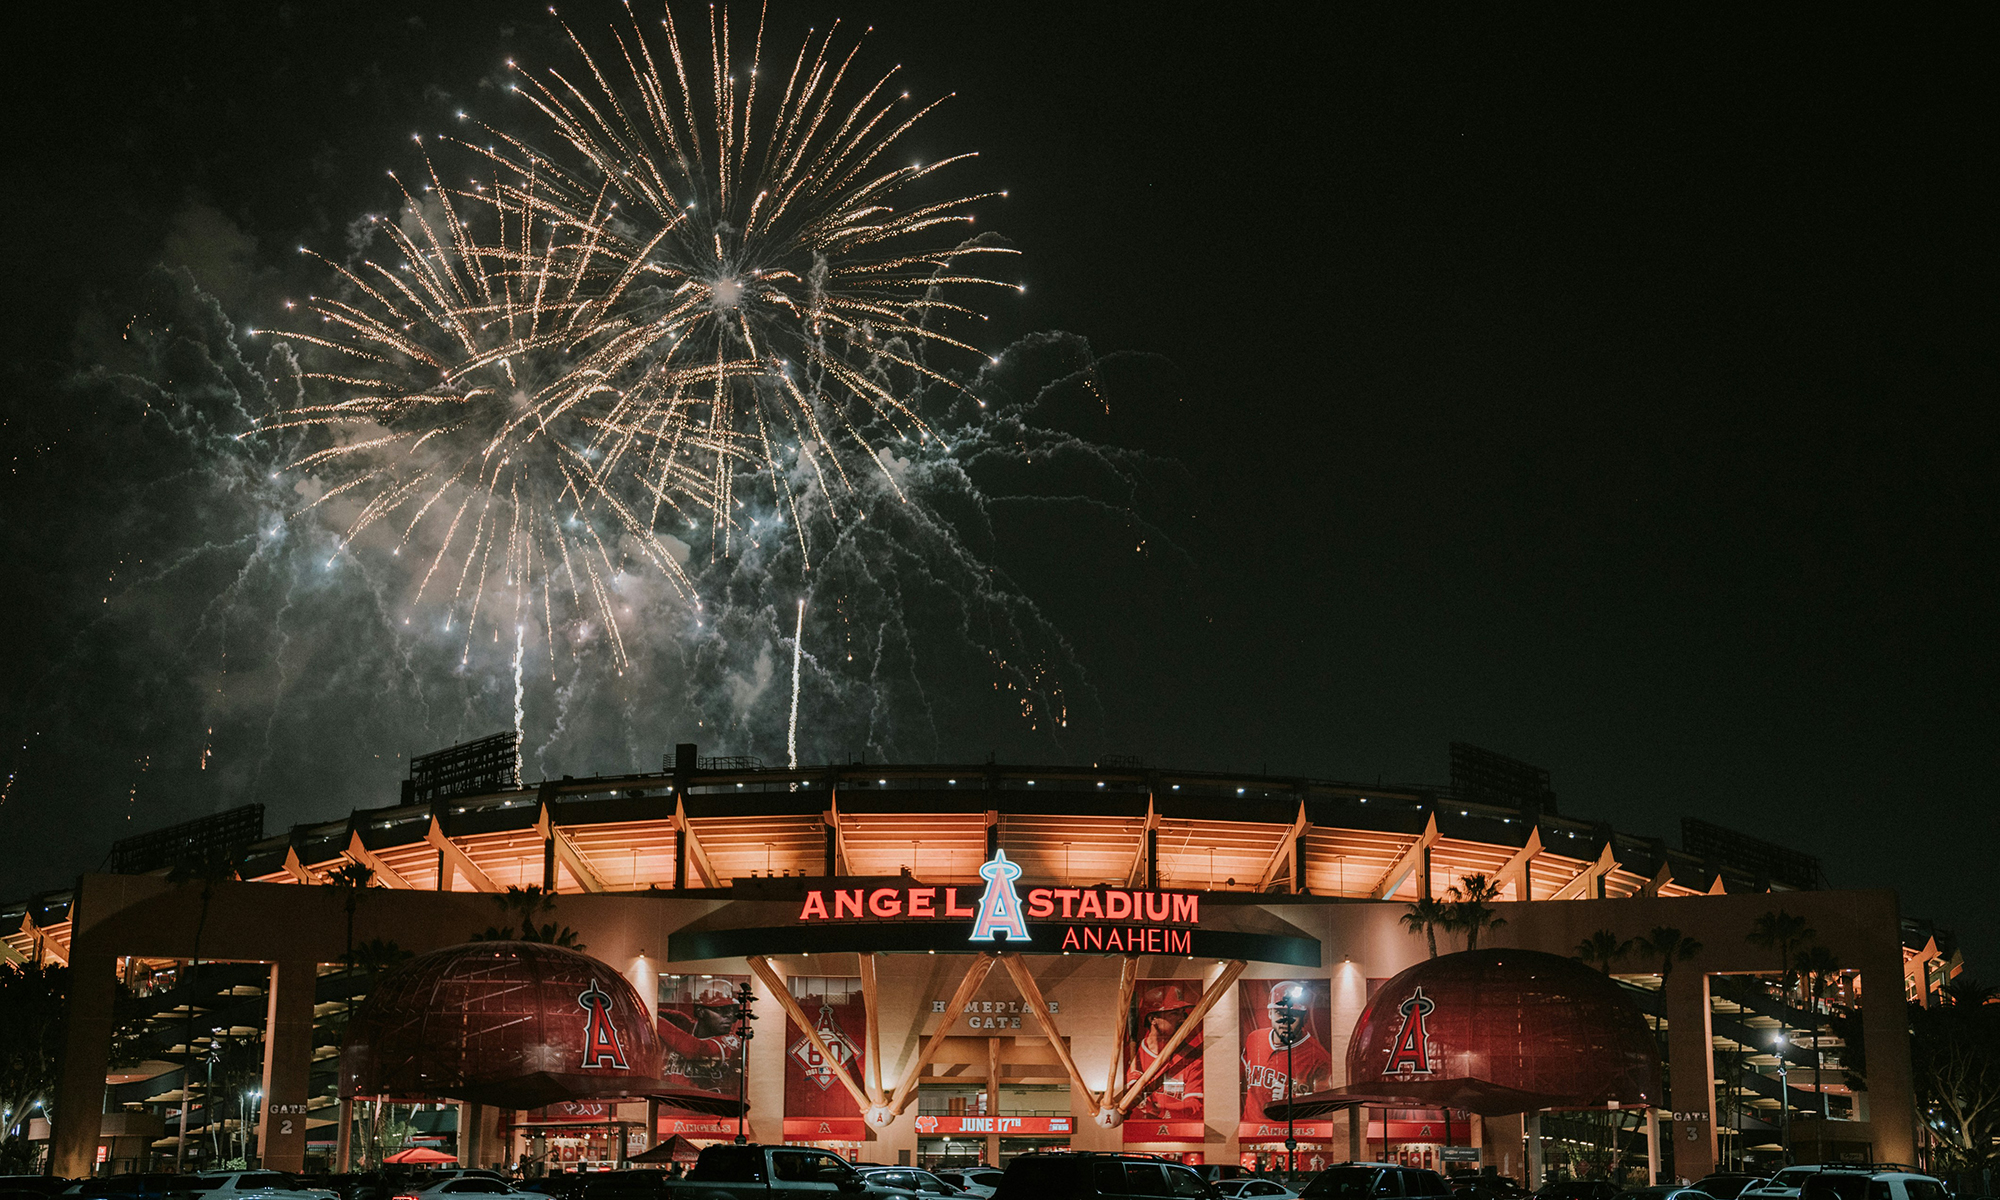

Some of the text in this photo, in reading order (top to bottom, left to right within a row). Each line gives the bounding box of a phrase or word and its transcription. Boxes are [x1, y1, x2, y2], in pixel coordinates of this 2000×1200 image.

[799, 887, 974, 920] ANGEL
[1027, 888, 1199, 923] STADIUM
[1062, 926, 1191, 953] ANAHEIM
[932, 1001, 1059, 1014] HMEPLAE
[968, 1017, 1021, 1029] GATE
[808, 1041, 842, 1065] 60
[269, 1104, 307, 1114] GATE
[1673, 1111, 1709, 1121] GATE
[280, 1119, 293, 1134] 2
[672, 1121, 732, 1133] ANGELS
[959, 1118, 1021, 1132] JUNE 17TH
[1257, 1124, 1315, 1136] ANGELS
[1686, 1127, 1698, 1141] 3
